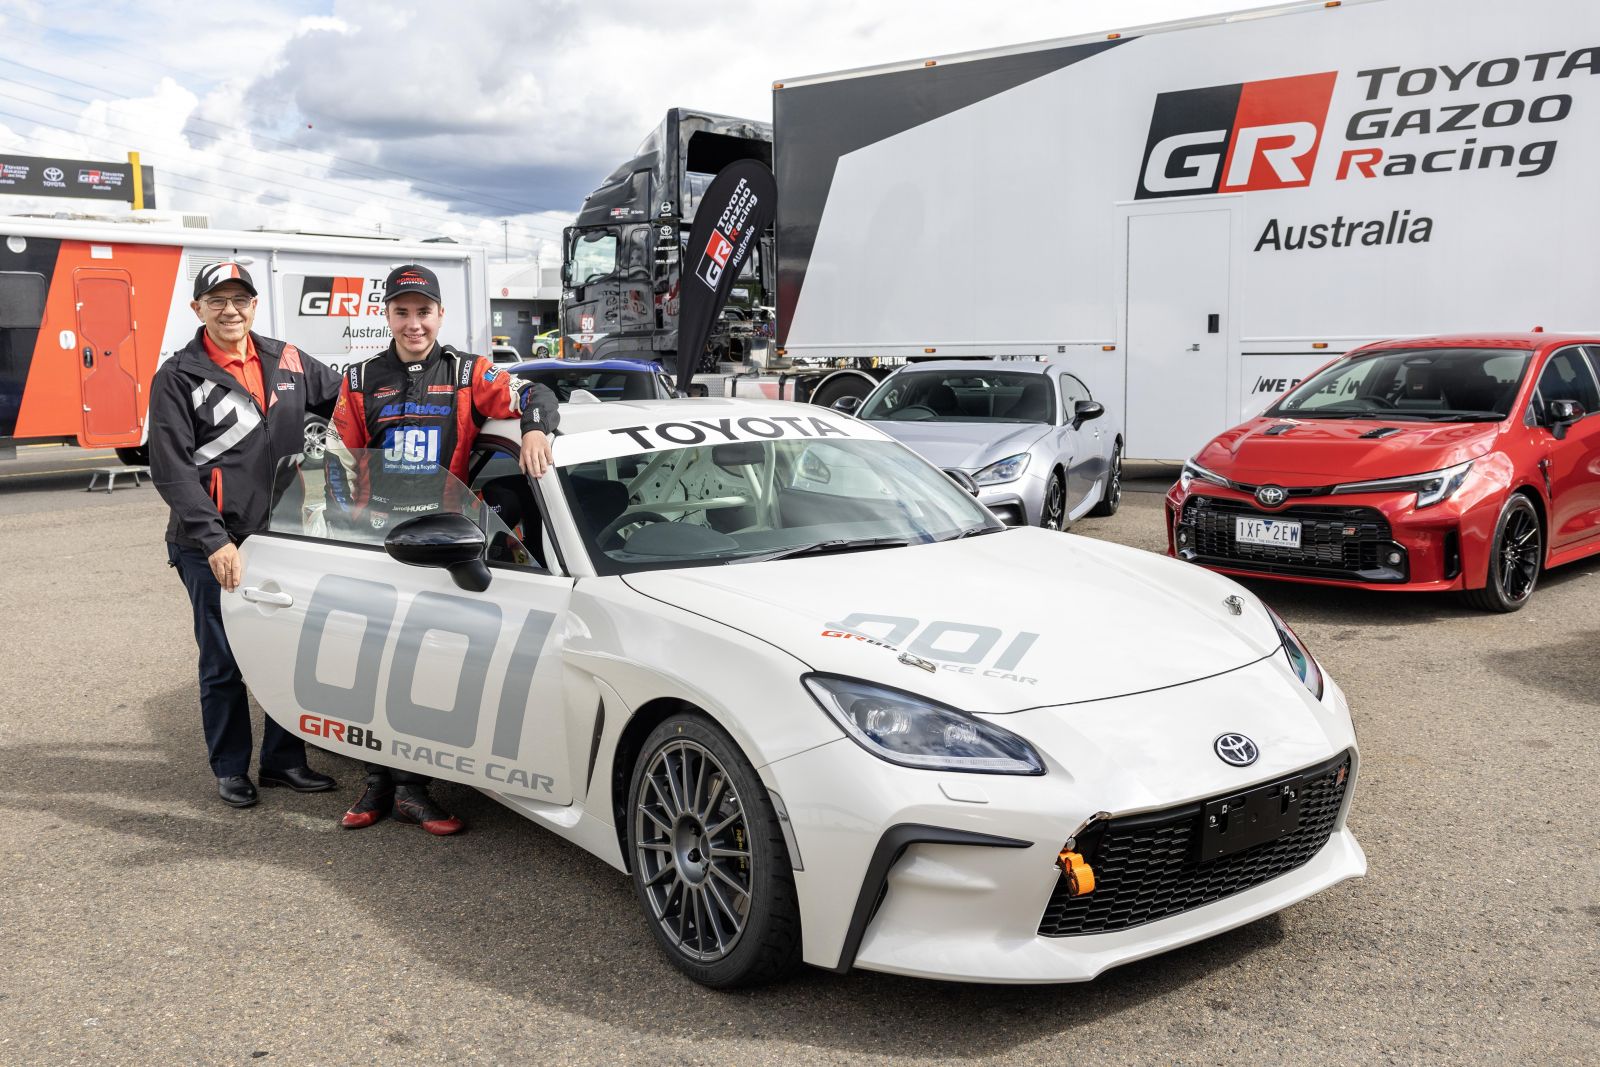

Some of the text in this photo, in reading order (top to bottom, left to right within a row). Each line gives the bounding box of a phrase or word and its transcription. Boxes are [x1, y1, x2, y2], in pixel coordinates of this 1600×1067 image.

[1357, 46, 1600, 100] TOYOTA
[1345, 94, 1573, 140] GAZOO
[1143, 121, 1318, 192] GR
[1335, 138, 1558, 180] Racing
[717, 177, 748, 229] TOYOTA
[724, 187, 751, 236] GAZOO
[730, 194, 758, 241] Racing
[732, 225, 755, 268] Australia
[1254, 210, 1434, 252] Australia
[705, 239, 734, 289] GR
[301, 291, 360, 315] GR
[581, 317, 594, 330] 50
[342, 326, 393, 338] Australia
[1251, 375, 1287, 395] /WE
[384, 429, 438, 462] JGI
[608, 416, 850, 450] TOYOTA
[373, 518, 384, 527] 52
[1240, 521, 1300, 542] 1XF 2EW
[293, 573, 557, 761] 001
[982, 669, 1039, 686] CAR
[299, 714, 555, 794] GR86 RACE CAR
